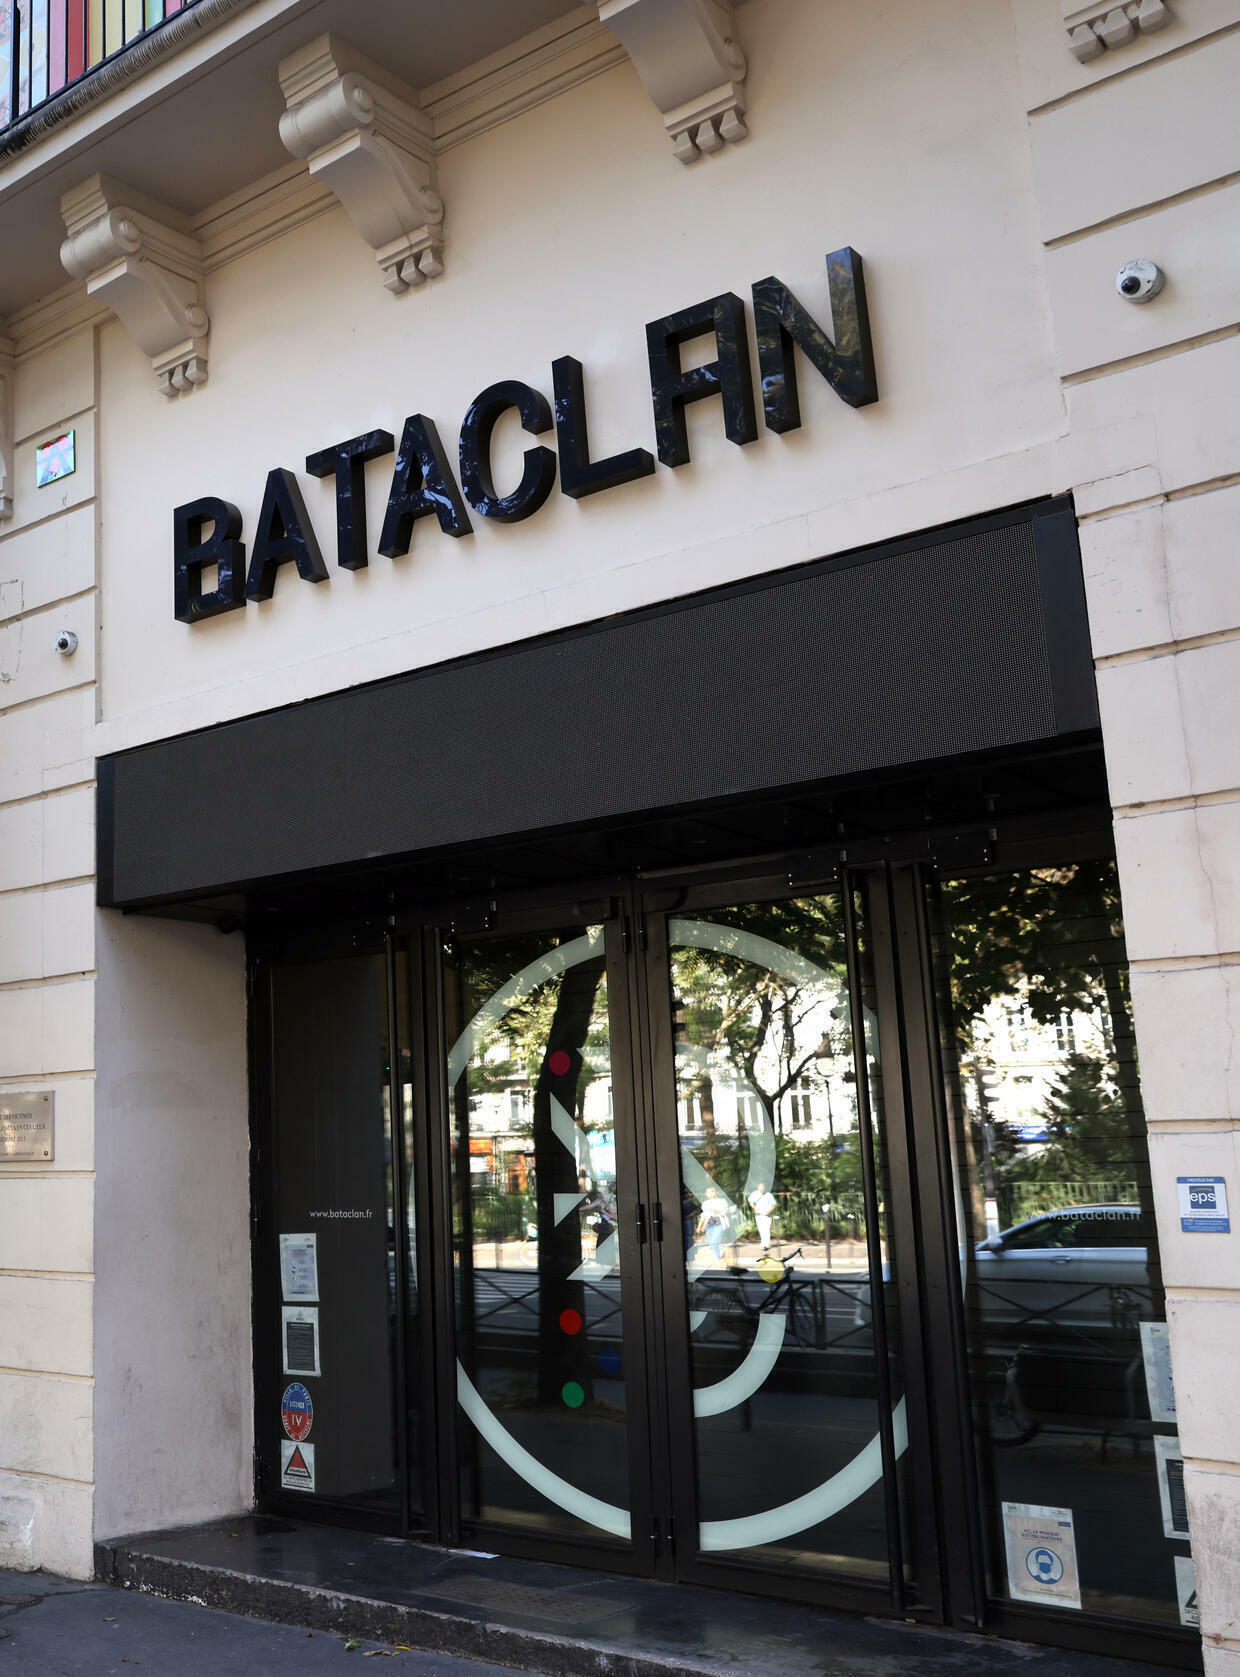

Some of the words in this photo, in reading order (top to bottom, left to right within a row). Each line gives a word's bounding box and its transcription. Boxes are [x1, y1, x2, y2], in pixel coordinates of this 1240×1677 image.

[174, 246, 879, 623] BATACLAN
[1190, 1192, 1216, 1205] eps
[309, 1208, 373, 1218] www.bataclan.fr
[291, 1414, 303, 1427] IV
